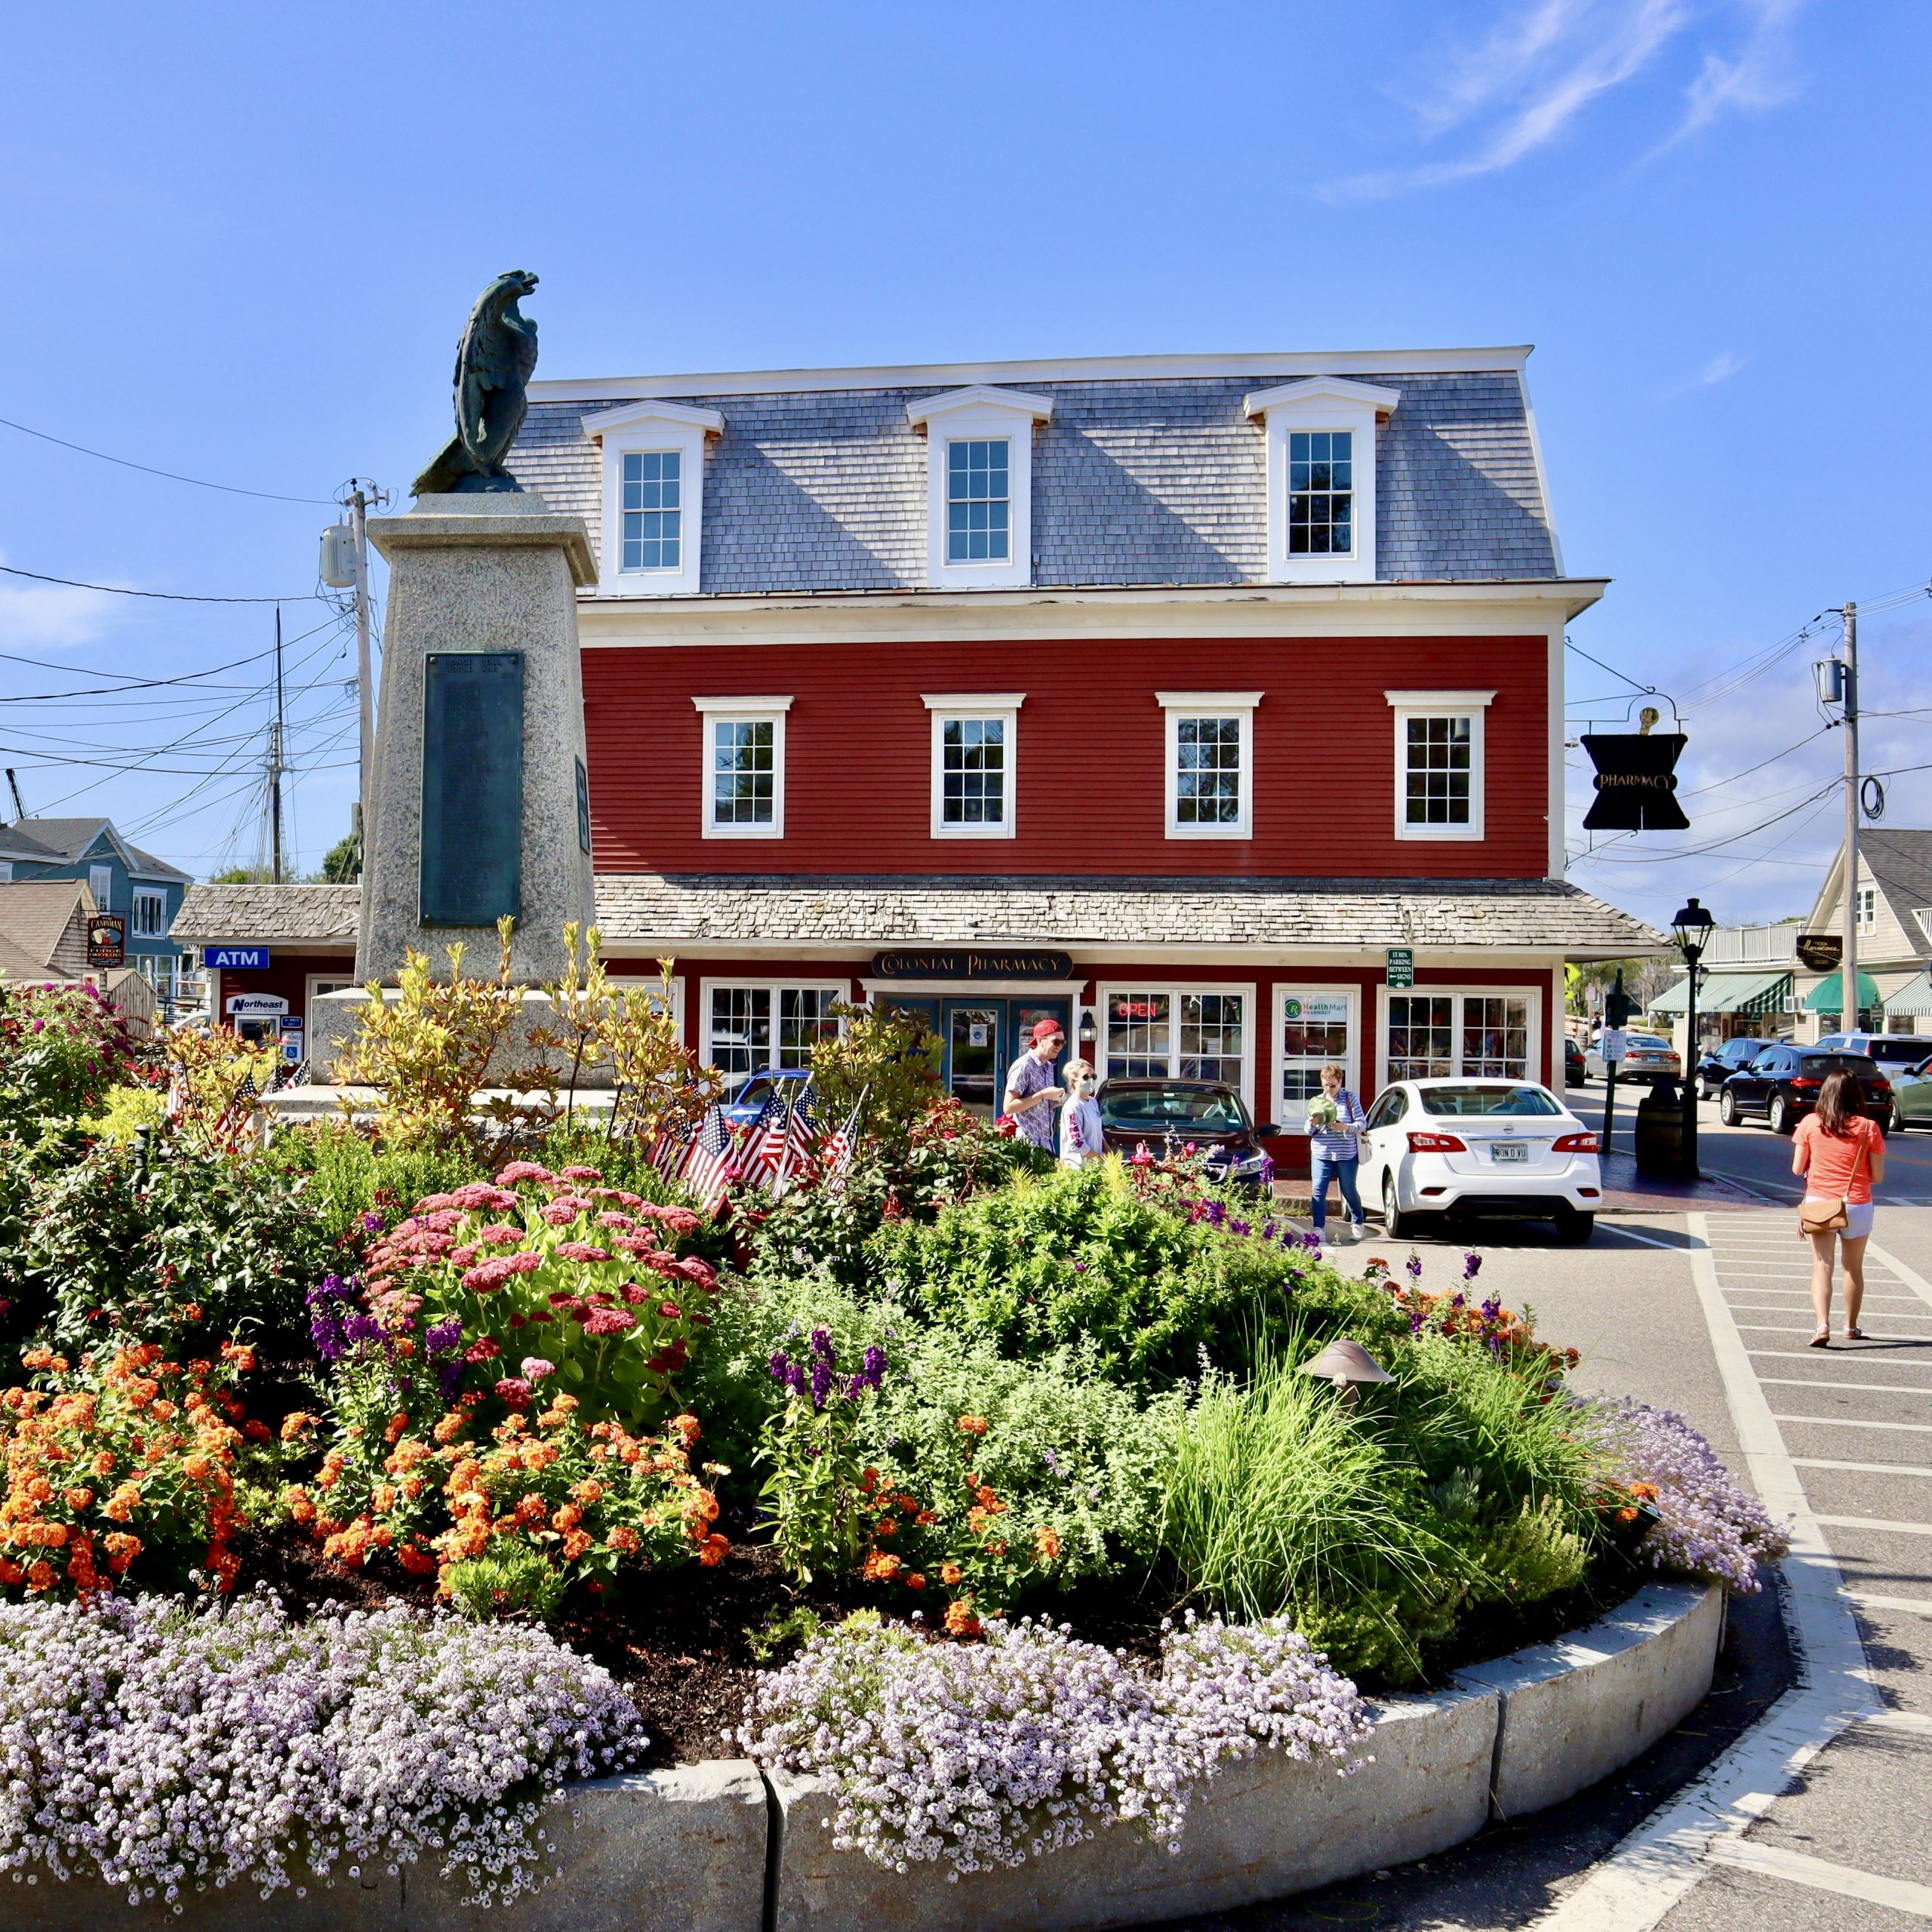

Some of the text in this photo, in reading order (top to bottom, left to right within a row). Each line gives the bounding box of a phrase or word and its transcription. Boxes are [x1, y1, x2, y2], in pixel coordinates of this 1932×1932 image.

[1599, 774, 1672, 790] PHARMACY
[91, 920, 122, 931] CANDYMAN
[215, 952, 259, 965] ATM
[881, 954, 1060, 975] COLONIAL PHARMACY
[232, 998, 283, 1011] Northeast
[1118, 1002, 1157, 1017] OPEN
[1517, 1148, 1526, 1158] VU
